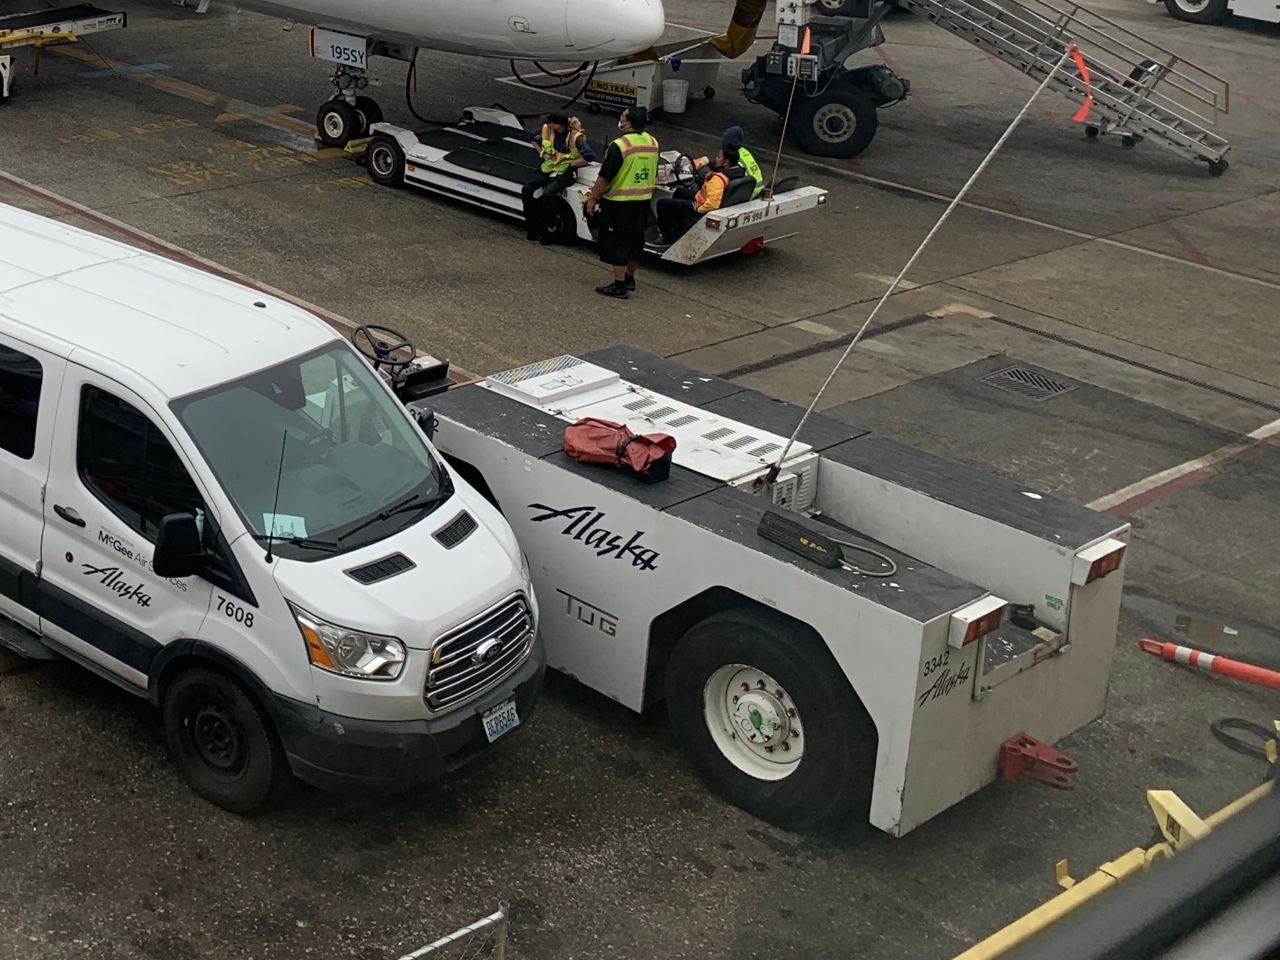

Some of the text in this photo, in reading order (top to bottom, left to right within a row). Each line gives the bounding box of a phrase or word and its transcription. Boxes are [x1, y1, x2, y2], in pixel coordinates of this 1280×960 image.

[330, 44, 365, 65] 195SY
[596, 82, 636, 96] NO TRASH
[97, 529, 134, 560] McGee
[133, 552, 149, 569] Air
[527, 502, 661, 571] Alaska
[80, 563, 153, 608] Alaska
[217, 595, 254, 629] 7608
[555, 587, 619, 638] TUG
[923, 650, 950, 677] 3342
[917, 660, 972, 708] Alaska
